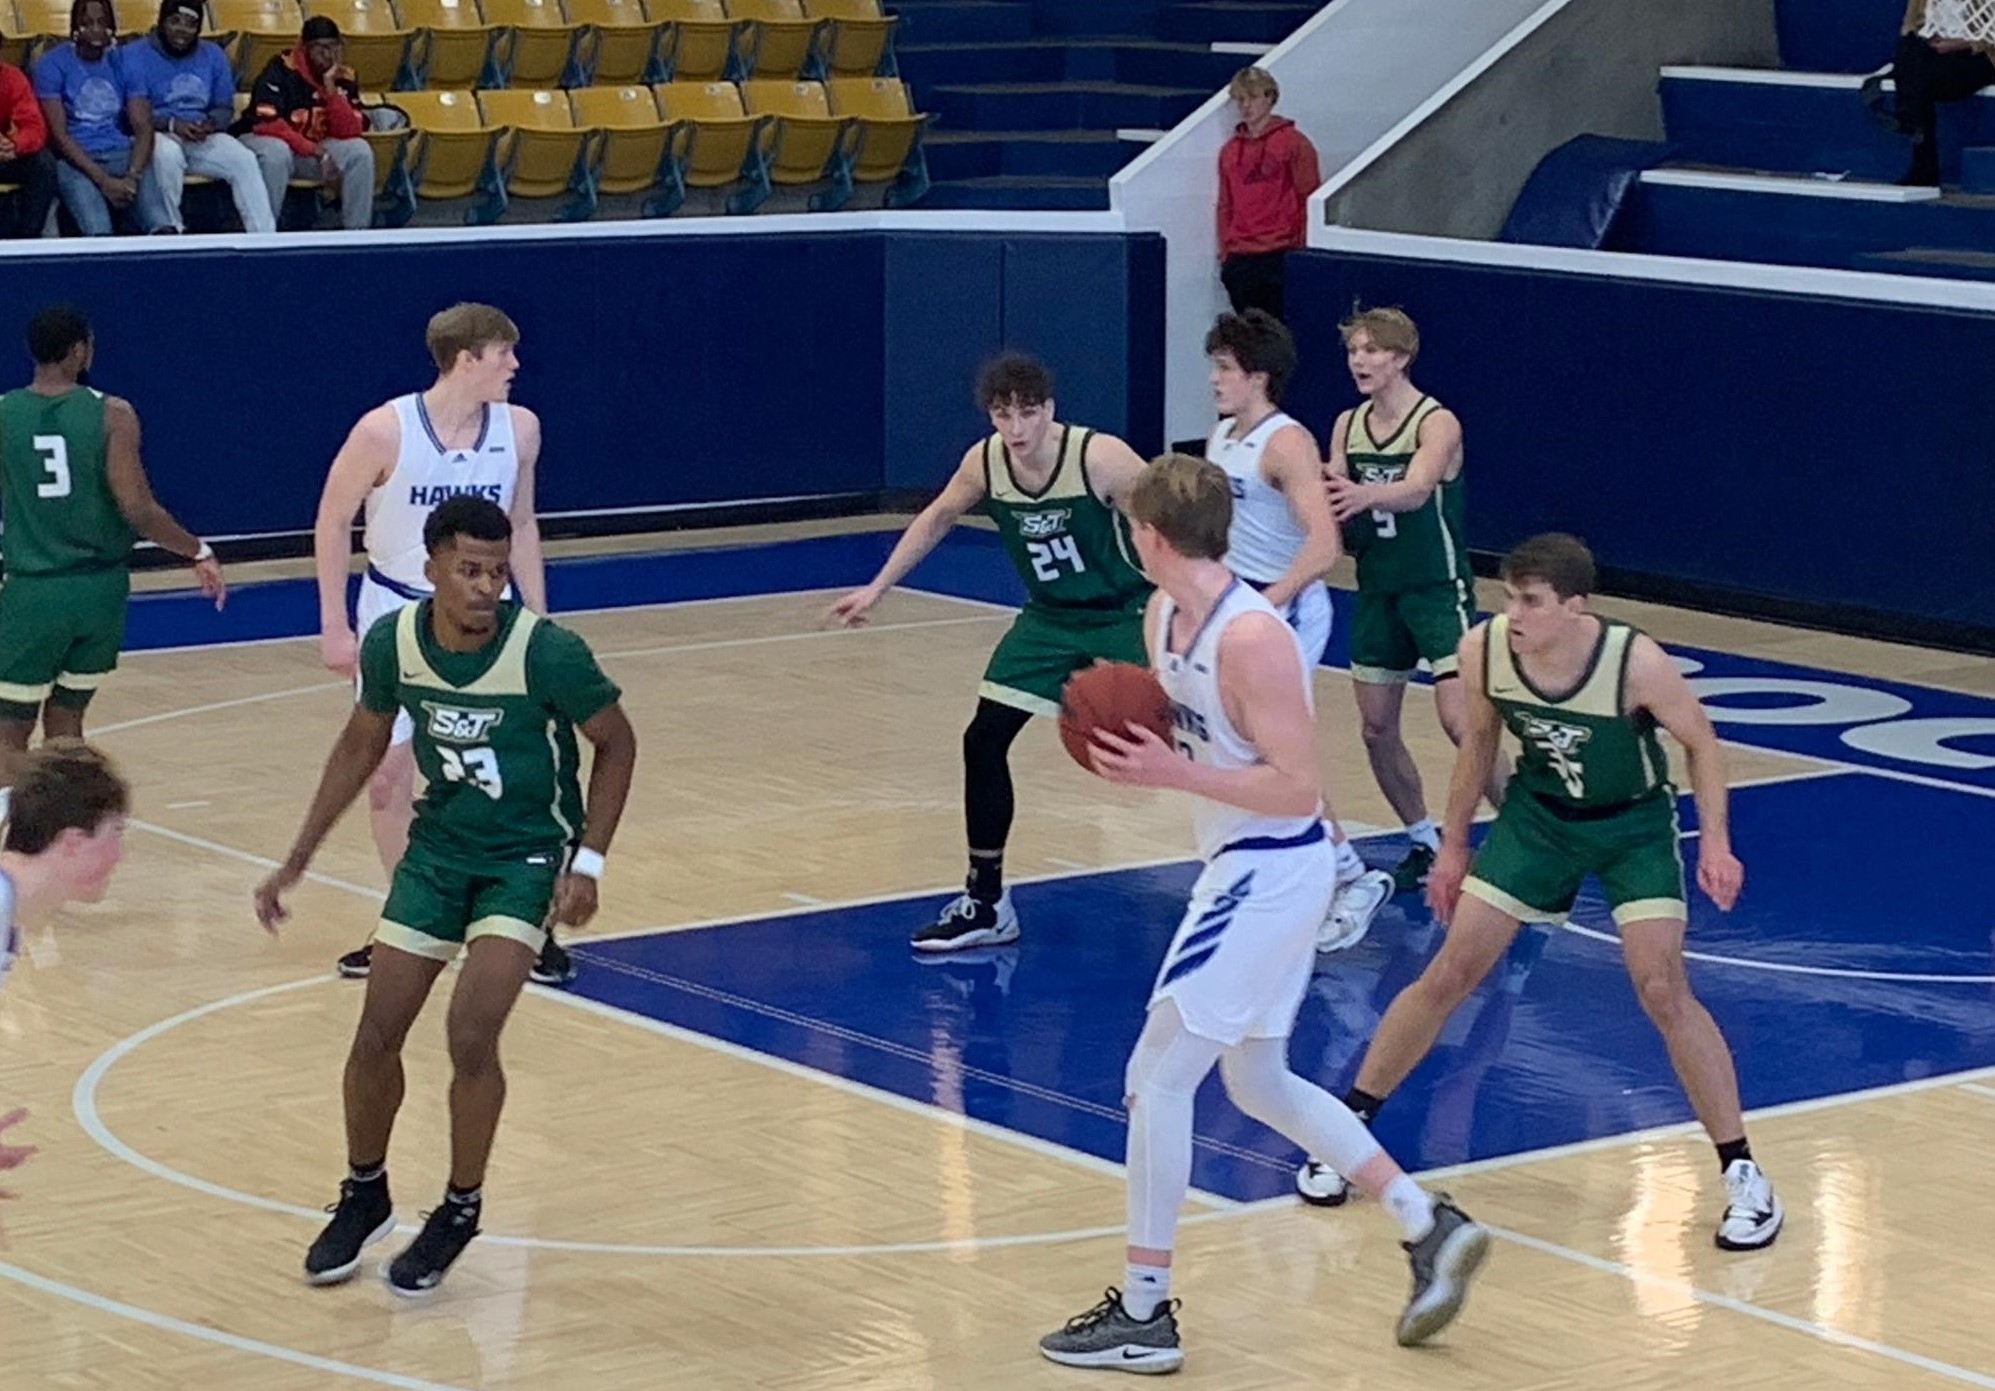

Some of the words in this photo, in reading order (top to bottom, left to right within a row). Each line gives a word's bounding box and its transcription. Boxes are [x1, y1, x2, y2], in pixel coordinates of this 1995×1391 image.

[33, 435, 71, 498] 3
[1022, 510, 1067, 535] S&T
[1026, 534, 1086, 582] 24
[428, 705, 499, 739] S&T
